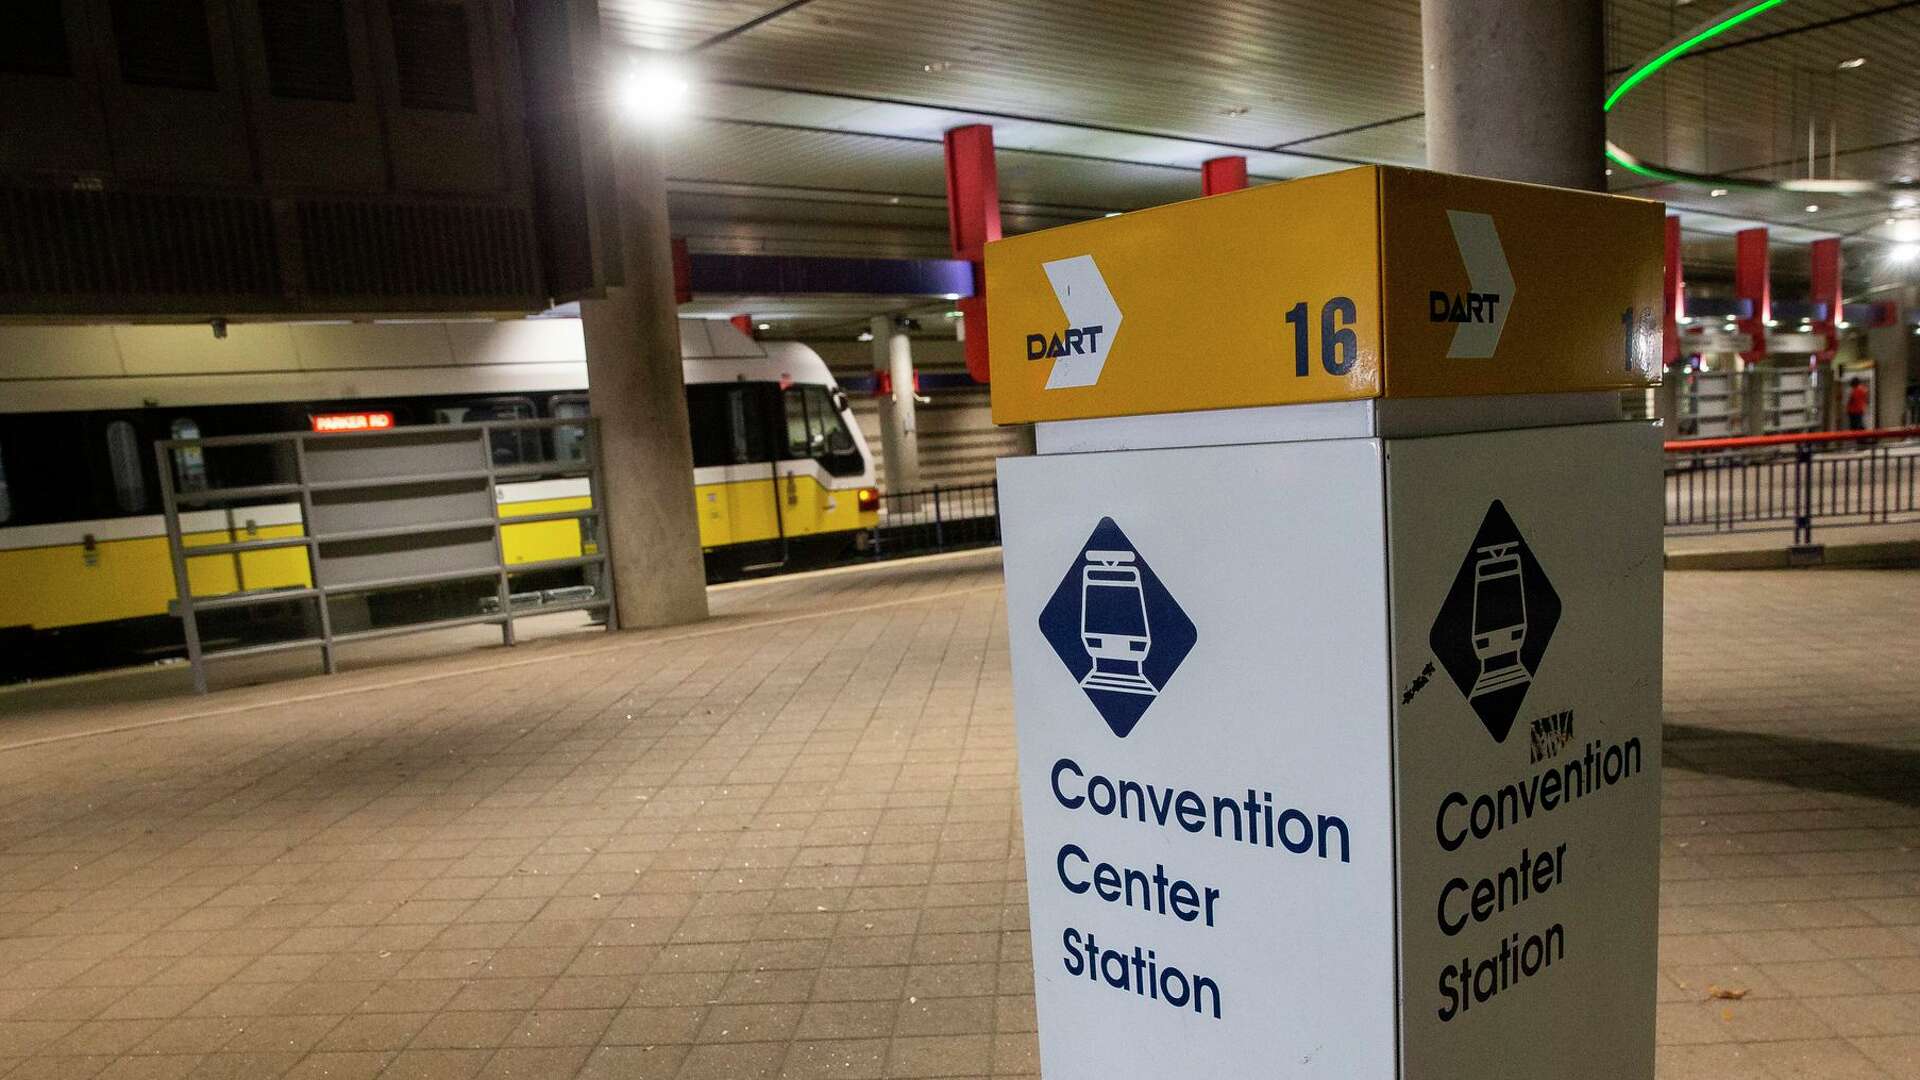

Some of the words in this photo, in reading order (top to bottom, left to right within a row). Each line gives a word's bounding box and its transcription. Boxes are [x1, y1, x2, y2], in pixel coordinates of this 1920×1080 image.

[1027, 325, 1102, 360] DART
[1285, 296, 1357, 377] 16
[1430, 291, 1500, 324] DART
[1051, 758, 1350, 864] Convention
[1436, 737, 1641, 851] Convention
[1057, 843, 1220, 928] Center
[1437, 843, 1566, 936] Center
[1063, 927, 1221, 1020] Station
[1438, 923, 1564, 1022] Station
